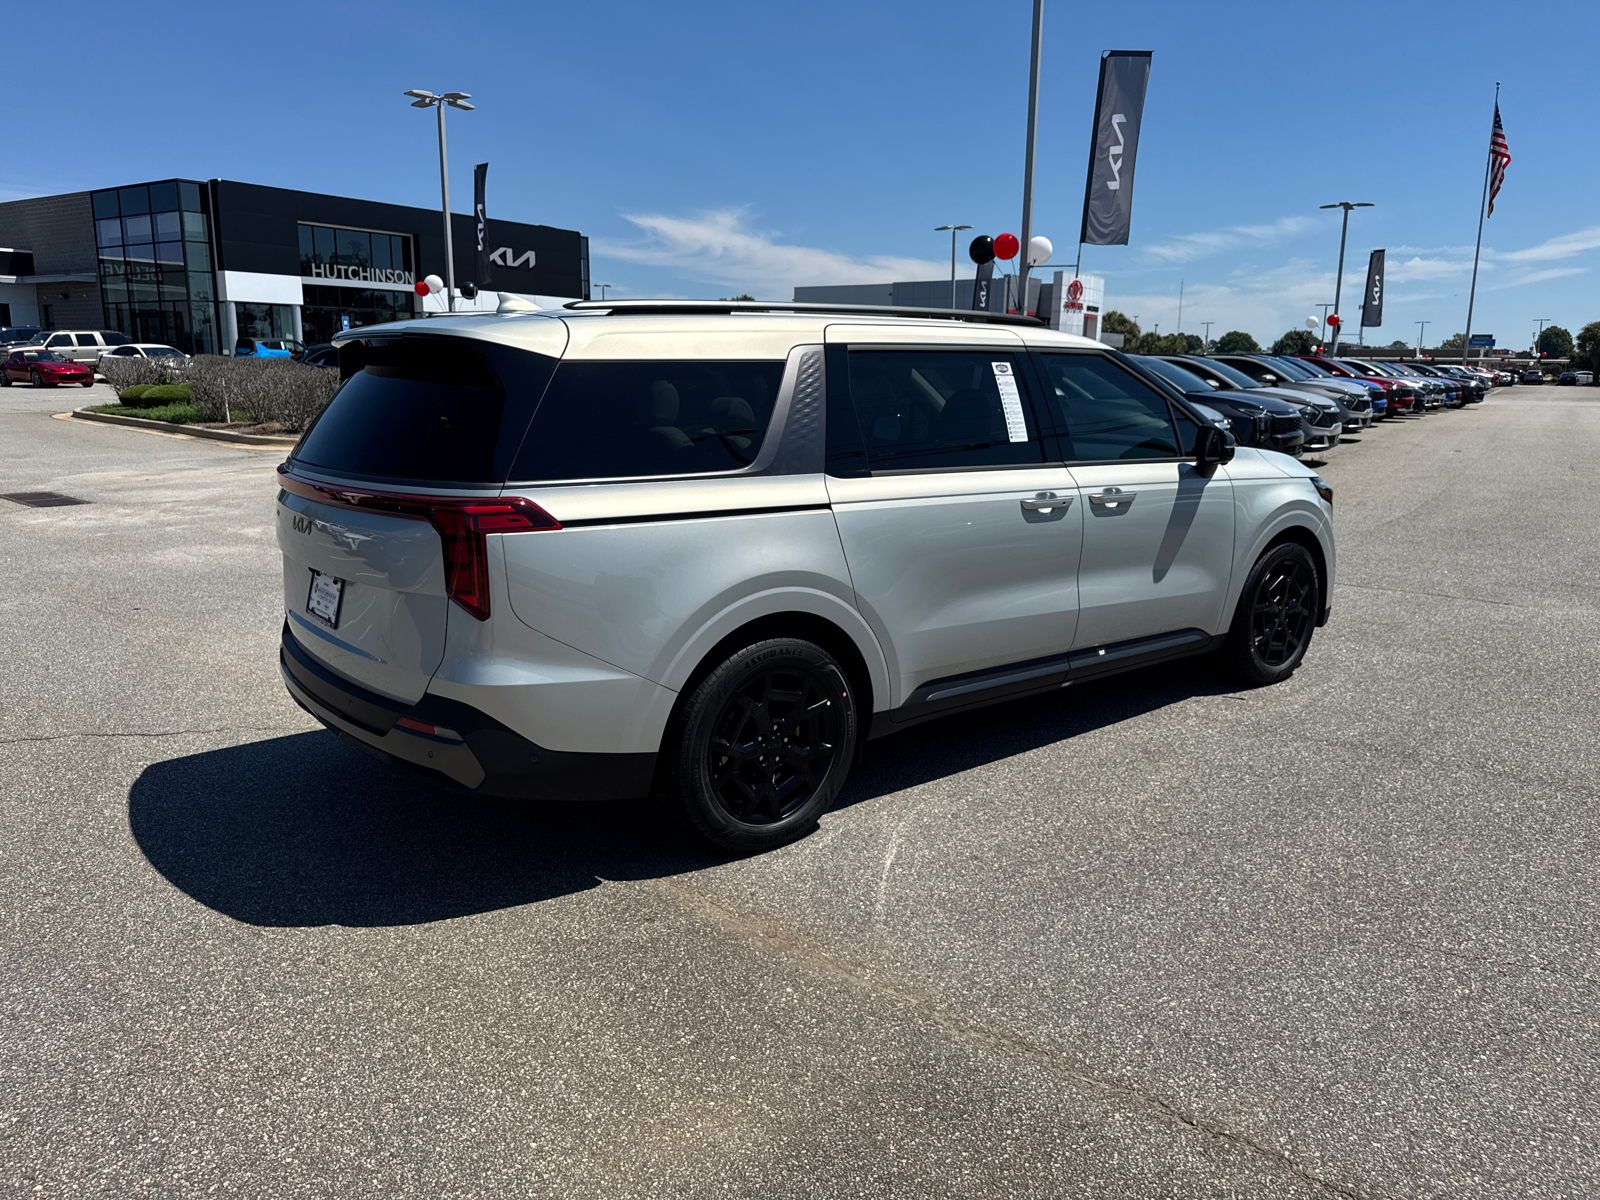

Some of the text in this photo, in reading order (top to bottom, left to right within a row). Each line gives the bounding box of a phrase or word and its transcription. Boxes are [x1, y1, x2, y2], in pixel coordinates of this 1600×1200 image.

[1106, 113, 1127, 190] KIA
[477, 203, 485, 251] KIA
[311, 262, 414, 285] HUTCHINSON
[979, 280, 988, 308] KIA
[1372, 274, 1380, 306] KIA
[293, 515, 312, 535] KIA
[744, 648, 805, 671] ASSURANCE
